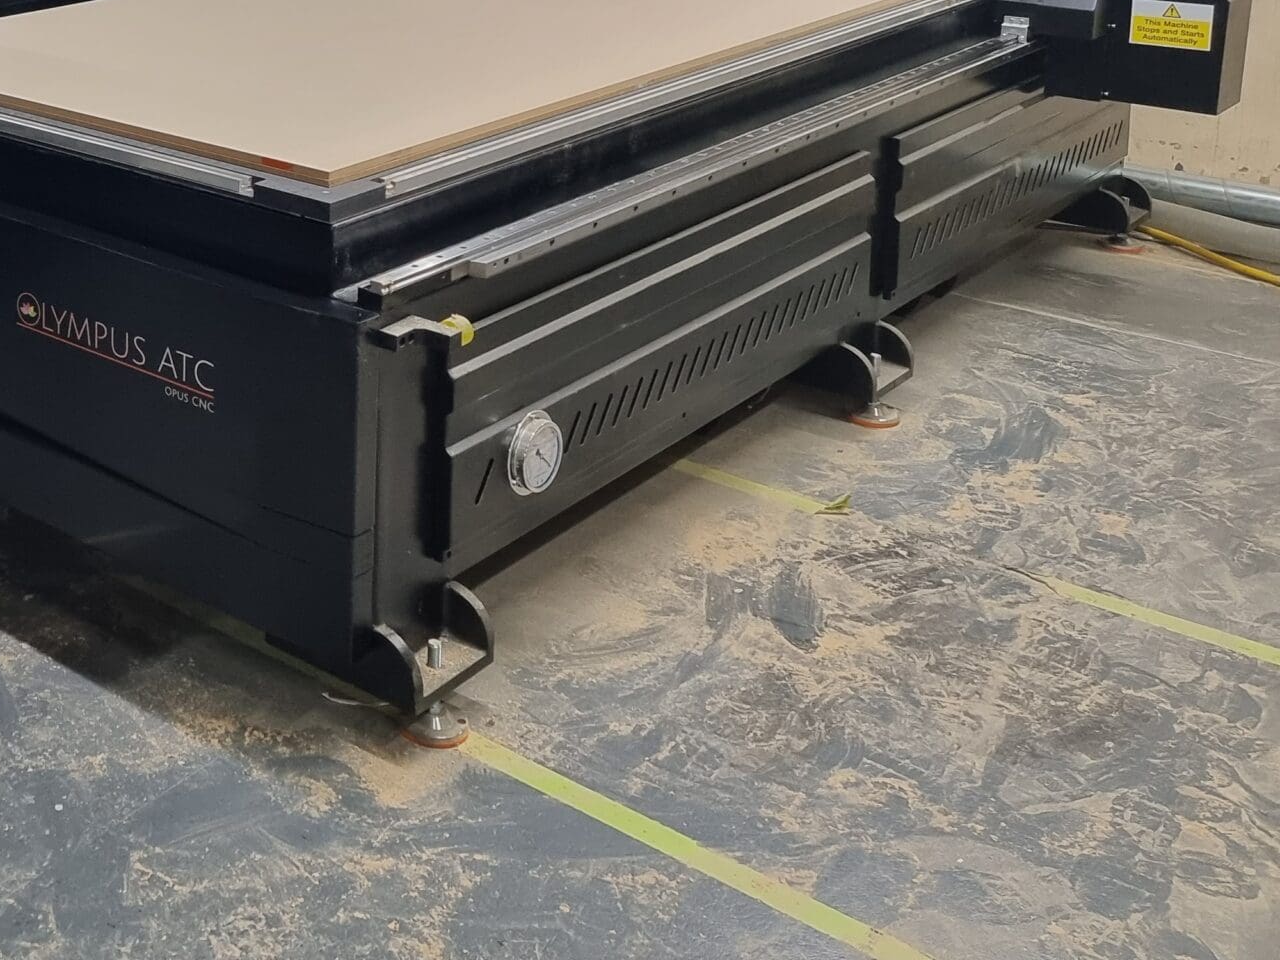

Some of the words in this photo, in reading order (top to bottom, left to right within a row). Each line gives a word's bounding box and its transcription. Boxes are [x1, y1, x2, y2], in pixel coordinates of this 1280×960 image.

[1144, 18, 1161, 26] This
[1164, 21, 1199, 30] Machine
[1136, 25, 1160, 34] Stops
[1180, 29, 1205, 38] Starts
[1142, 33, 1198, 45] Automatically
[16, 292, 146, 366] OLYMPUS
[157, 346, 215, 392] ATC
[164, 386, 189, 403] OPUS
[191, 396, 215, 413] CNC
